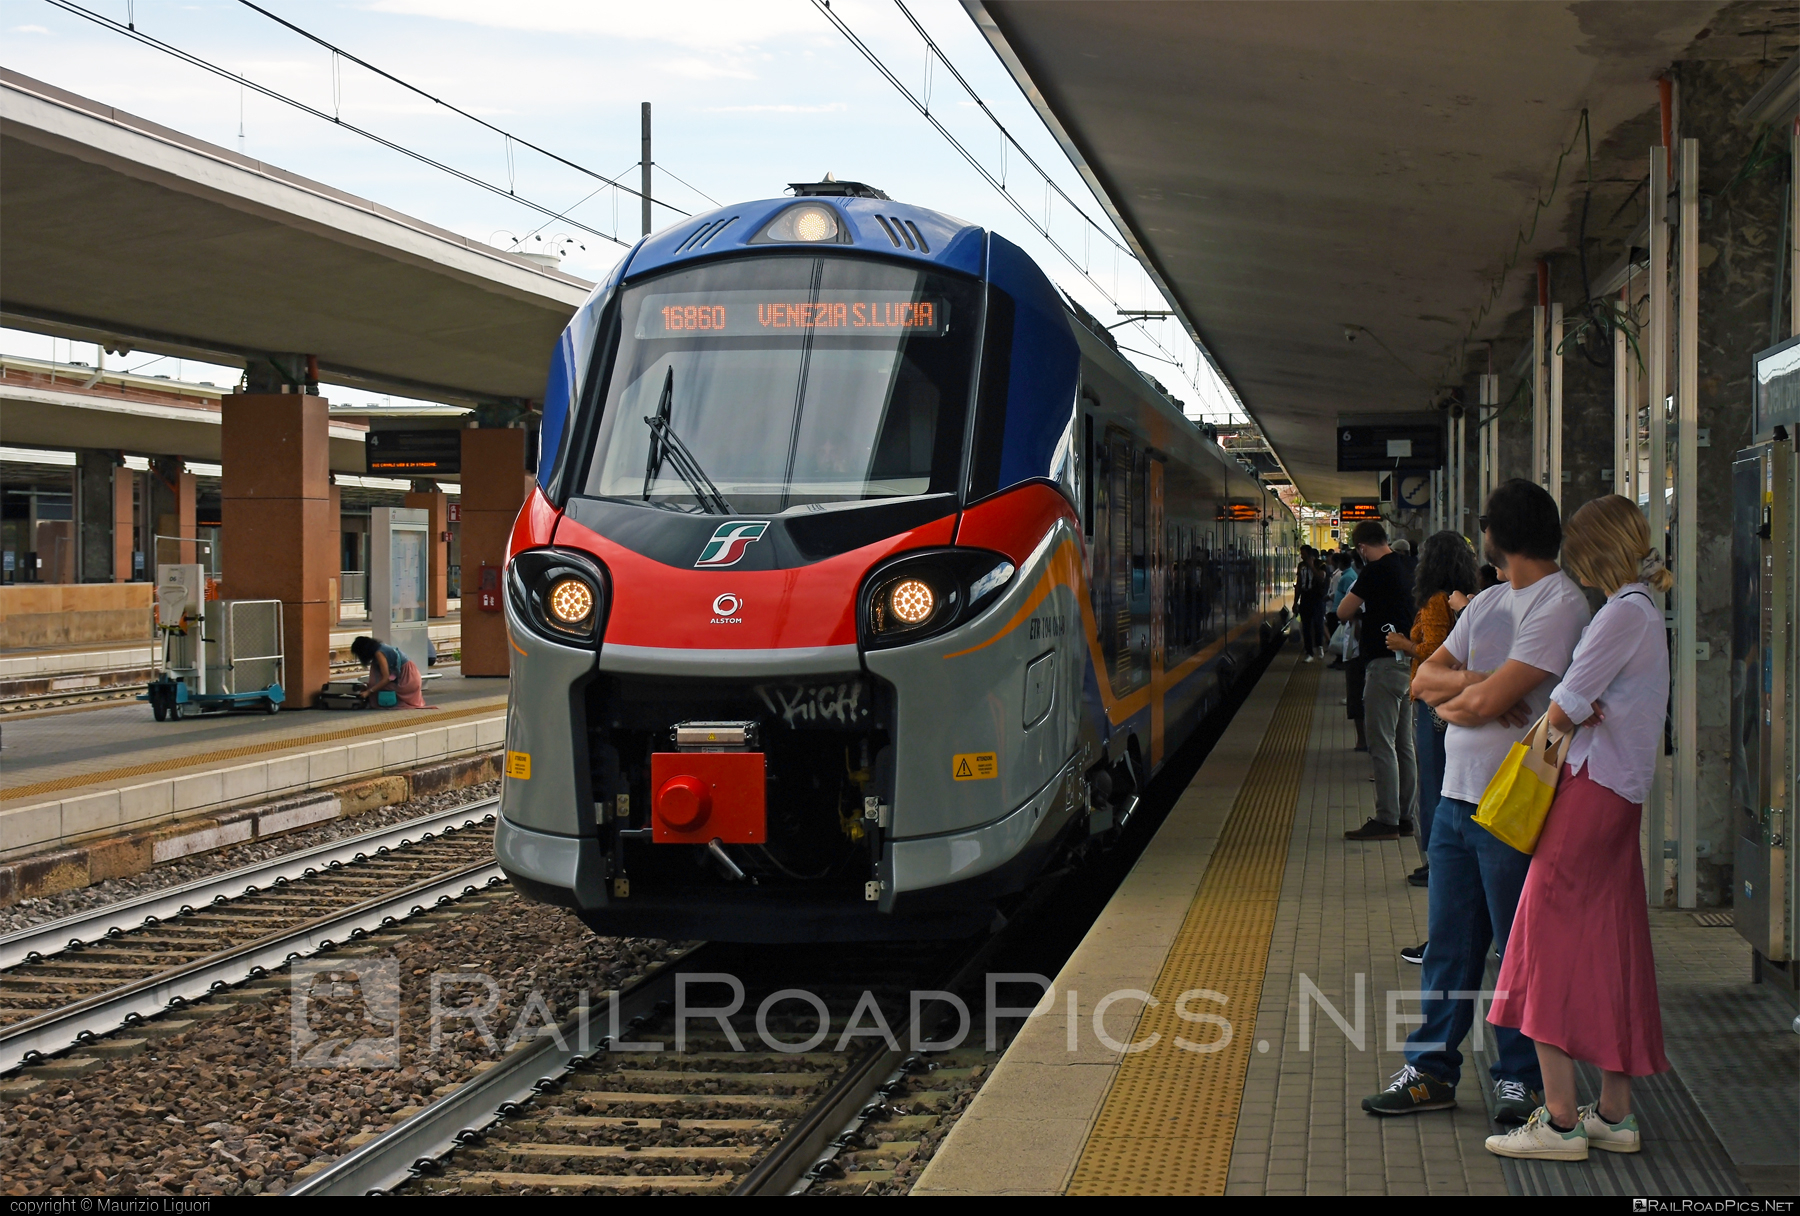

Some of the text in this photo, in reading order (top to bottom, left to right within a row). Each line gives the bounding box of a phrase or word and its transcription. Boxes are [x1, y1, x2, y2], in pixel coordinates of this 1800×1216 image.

[661, 302, 933, 330] 16860 VENEZIA S.LUCIA
[371, 436, 379, 446] 4
[1343, 431, 1351, 441] 6
[1030, 617, 1040, 640] ETR
[1408, 1083, 1431, 1104] N
